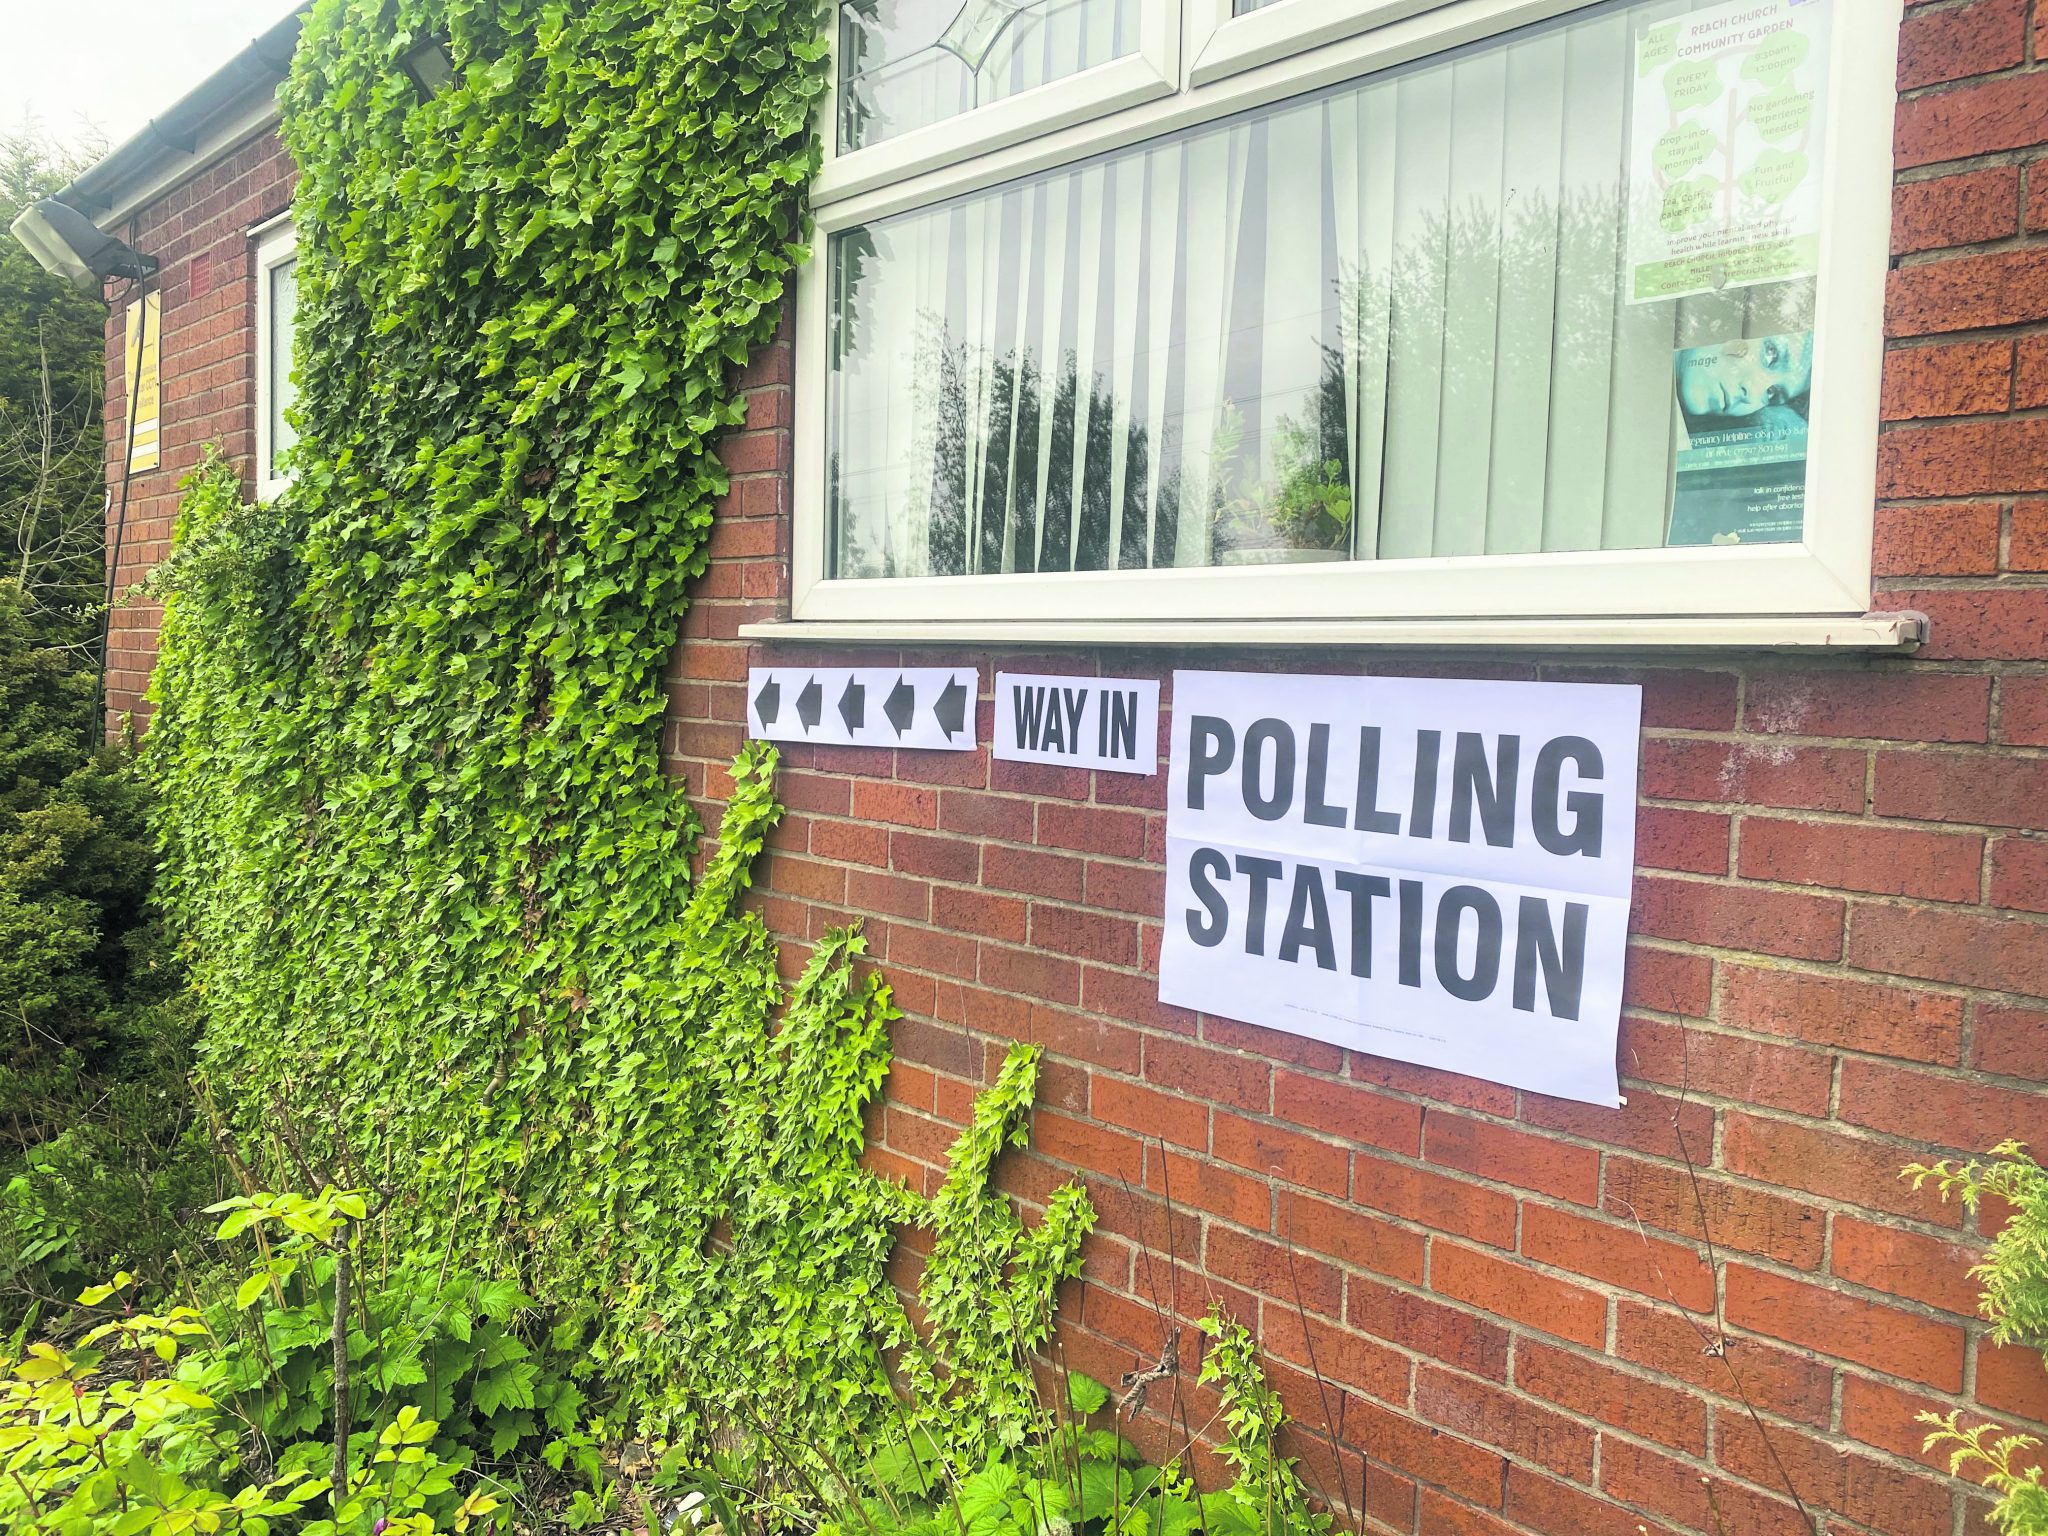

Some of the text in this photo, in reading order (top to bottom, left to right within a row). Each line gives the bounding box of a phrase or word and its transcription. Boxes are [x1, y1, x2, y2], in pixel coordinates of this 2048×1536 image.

[1692, 4, 1777, 37] REACH CHURCH
[1648, 33, 1664, 45] ALL
[1677, 17, 1794, 57] COMMUNITY GARDEN
[1643, 44, 1669, 59] AGES
[1676, 70, 1708, 86] EVERY
[1673, 83, 1710, 98] FRIDAY
[1754, 106, 1808, 124] experience
[1762, 120, 1799, 136] needed
[1668, 144, 1686, 157] stay
[1664, 155, 1704, 172] morning
[1719, 234, 1751, 247] learnin
[1686, 355, 1718, 368] mage
[1013, 684, 1139, 761] WAY IN
[1186, 714, 1604, 859] POLLING
[1185, 846, 1590, 1023] STATION
